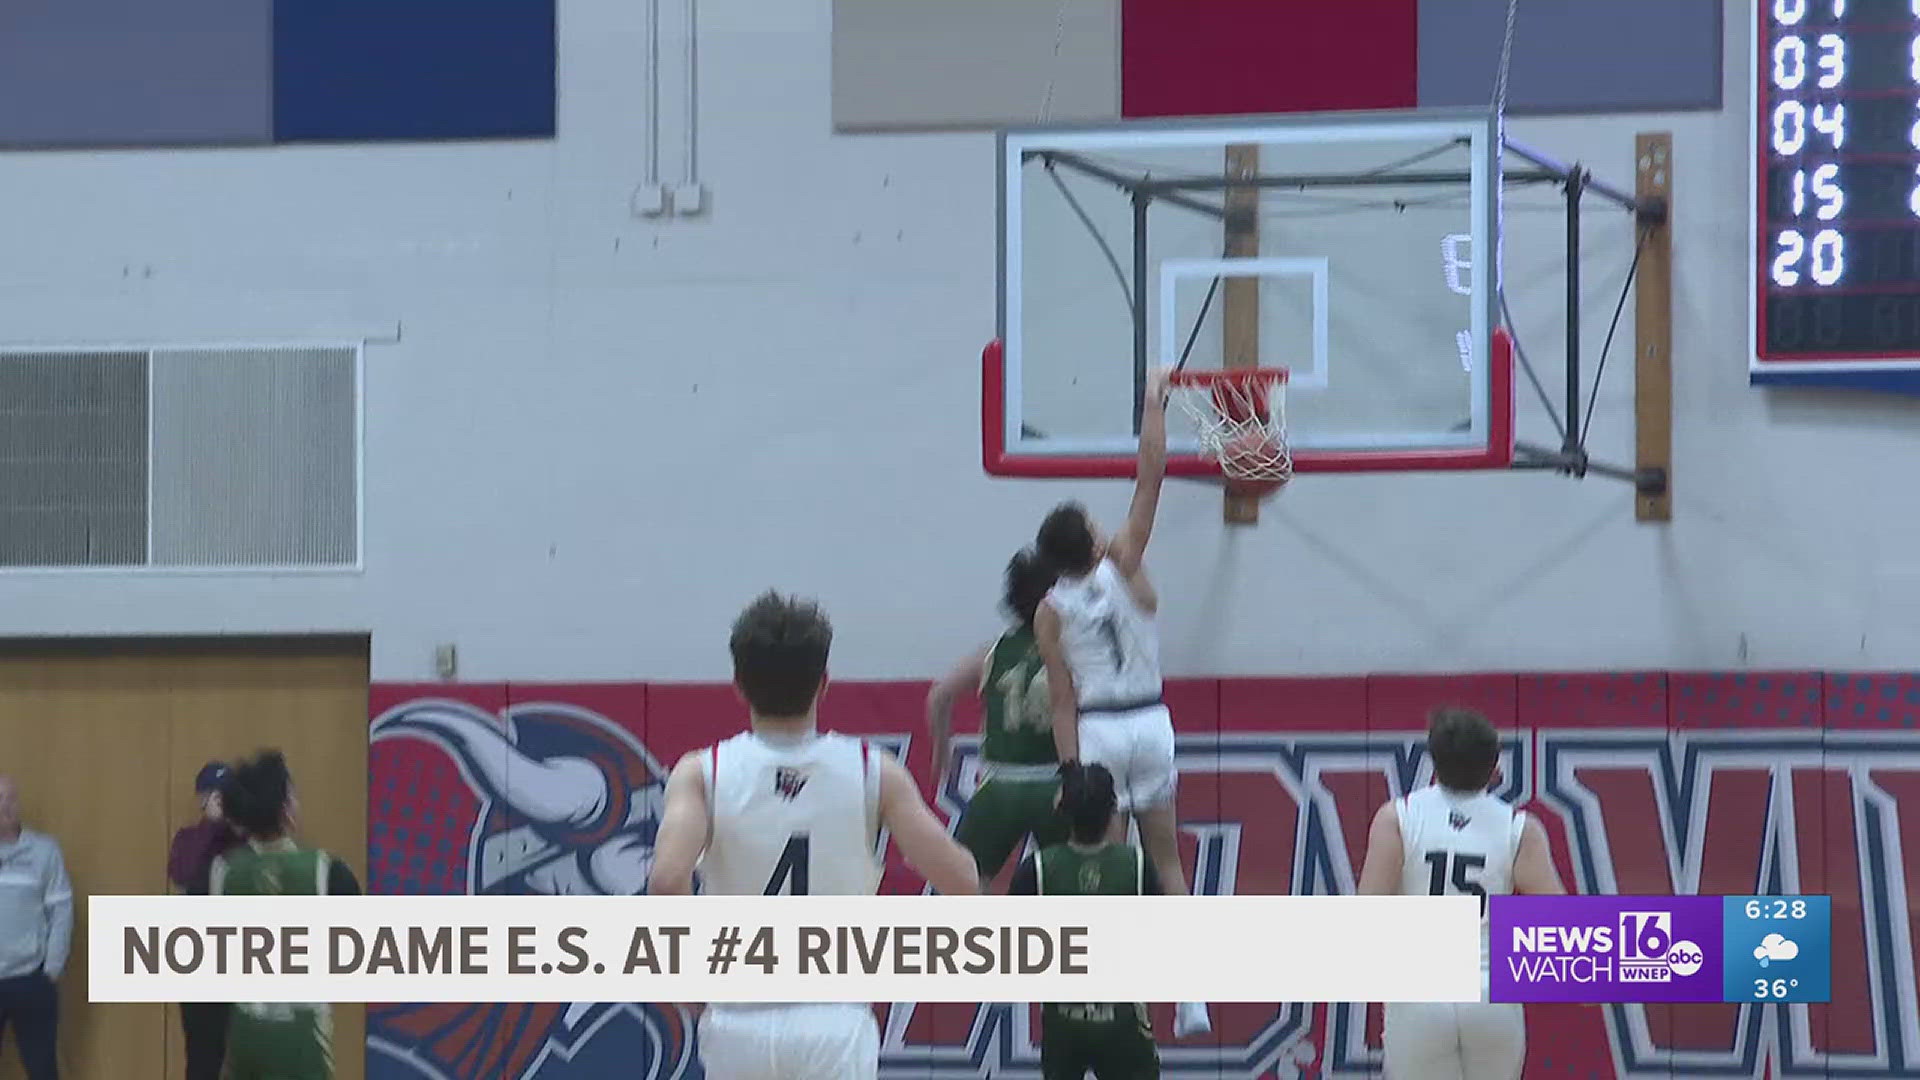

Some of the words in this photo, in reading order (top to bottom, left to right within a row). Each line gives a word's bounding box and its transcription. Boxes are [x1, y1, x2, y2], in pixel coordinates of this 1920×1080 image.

[1774, 34, 1844, 90] 03
[1774, 100, 1844, 155] 04
[1792, 164, 1844, 220] 15
[1773, 229, 1844, 286] 20
